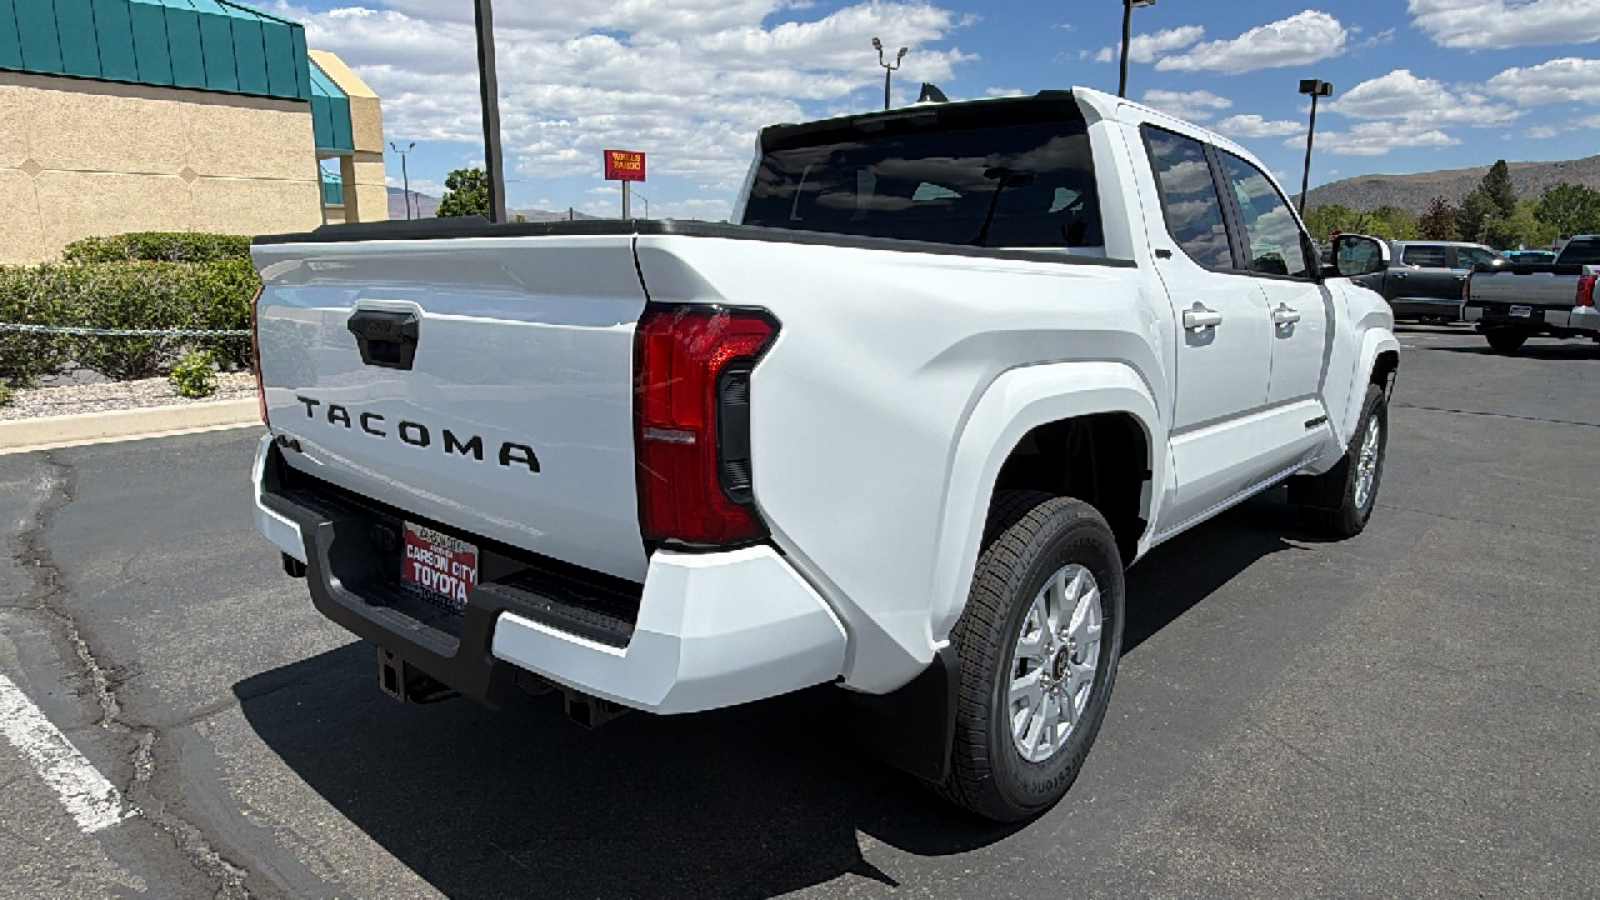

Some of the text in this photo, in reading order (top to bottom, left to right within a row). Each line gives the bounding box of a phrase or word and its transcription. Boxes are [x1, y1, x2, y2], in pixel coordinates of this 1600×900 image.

[297, 395, 541, 473] TACOMA
[406, 544, 449, 573] CARSON
[452, 561, 476, 583] CITY
[413, 562, 468, 604] TOYOTA
